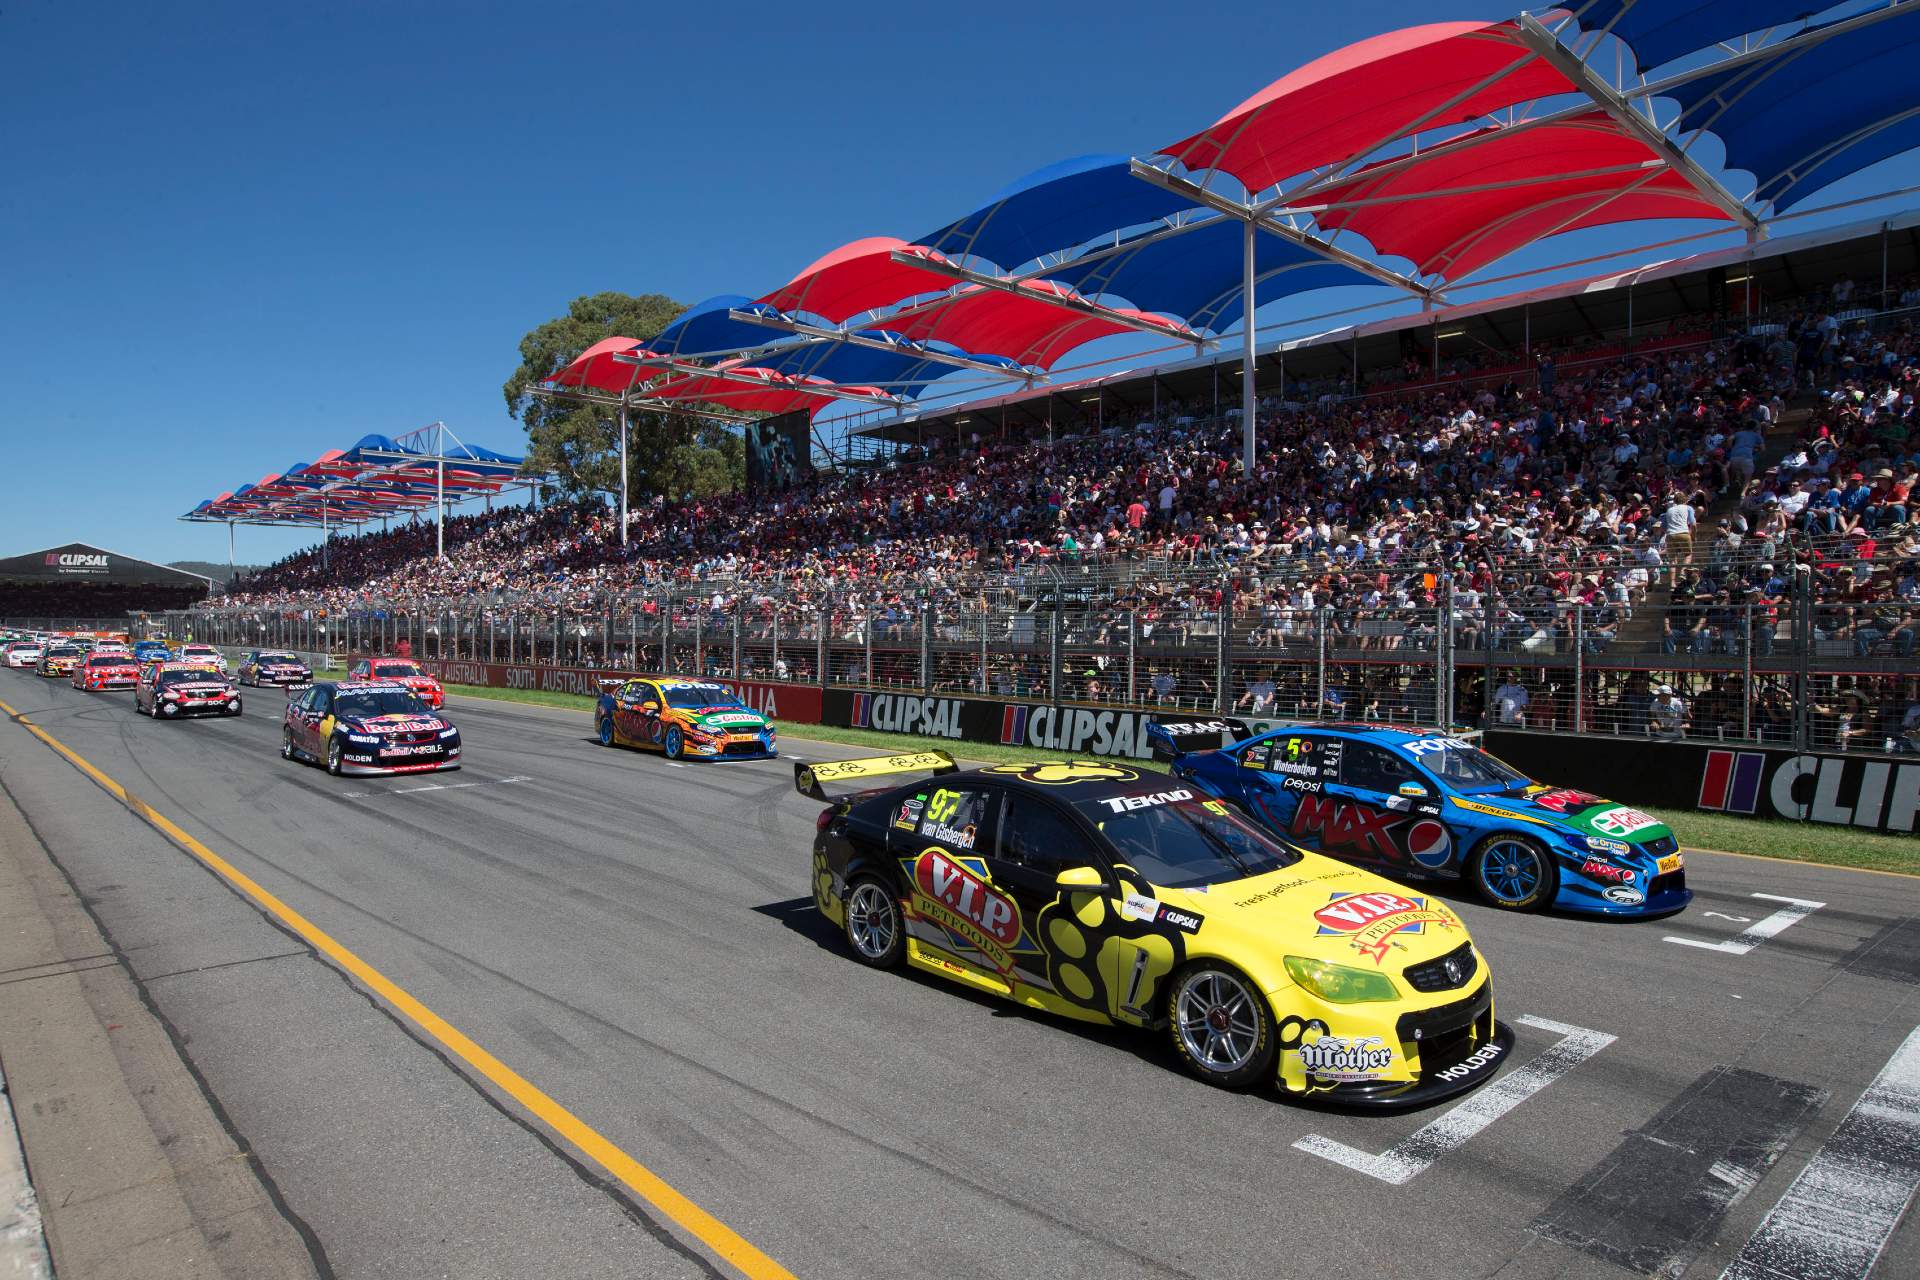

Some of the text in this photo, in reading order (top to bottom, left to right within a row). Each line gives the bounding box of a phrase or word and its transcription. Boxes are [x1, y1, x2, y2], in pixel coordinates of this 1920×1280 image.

[60, 554, 108, 566] CLIPSAL
[421, 662, 489, 686] SOUTH AUSTRALIA
[506, 668, 602, 697] SOUTH AUSTRAL
[662, 683, 721, 691] FORD
[363, 720, 444, 733] Red Bull
[871, 694, 963, 739] CLIPSAL
[1028, 706, 1154, 759] CLIPSAL
[1287, 739, 1301, 761] 5
[1402, 738, 1474, 755] FORD
[344, 754, 372, 762] HOLDEN
[1273, 760, 1317, 777] Winterbottom
[1284, 778, 1322, 793] pepsi
[928, 788, 961, 822] 97
[1098, 789, 1193, 813] TEKNO
[1473, 803, 1517, 817] DUNLOP
[922, 822, 937, 838] van
[1292, 794, 1411, 863] MAX
[1586, 854, 1608, 864] pepsi
[1581, 861, 1625, 881] MAX
[1235, 893, 1269, 908] Fresh
[1166, 911, 1199, 929] CLIPSAL
[1366, 910, 1437, 941] PETFOODS
[921, 900, 1004, 961] PETFOODS
[1300, 1036, 1393, 1072] Mother
[1435, 1043, 1504, 1082] HOLDEN
